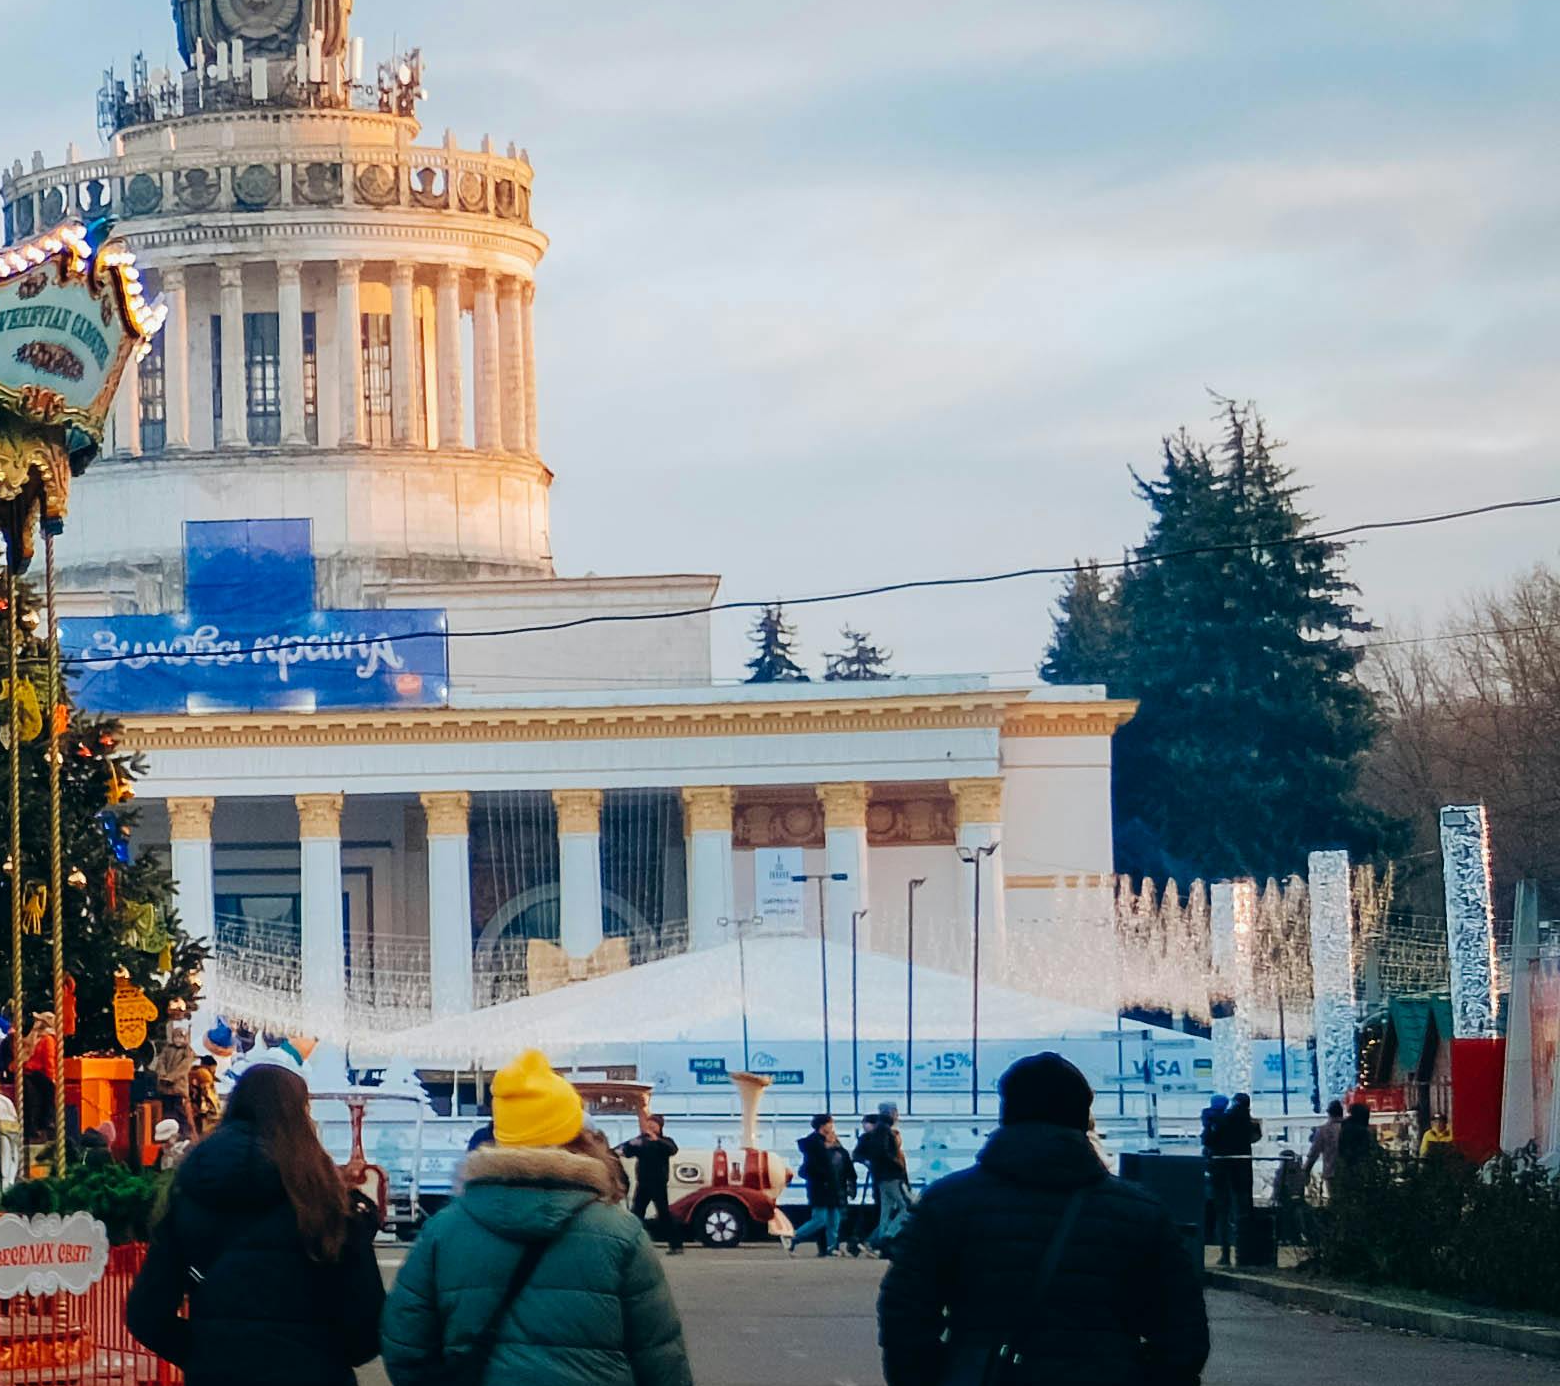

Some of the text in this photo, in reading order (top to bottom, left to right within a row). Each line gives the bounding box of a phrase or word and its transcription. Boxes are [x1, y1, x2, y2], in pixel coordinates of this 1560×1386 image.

[867, 1053, 904, 1069] -5%
[926, 1053, 972, 1070] -15%
[1133, 1060, 1181, 1076] VSA
